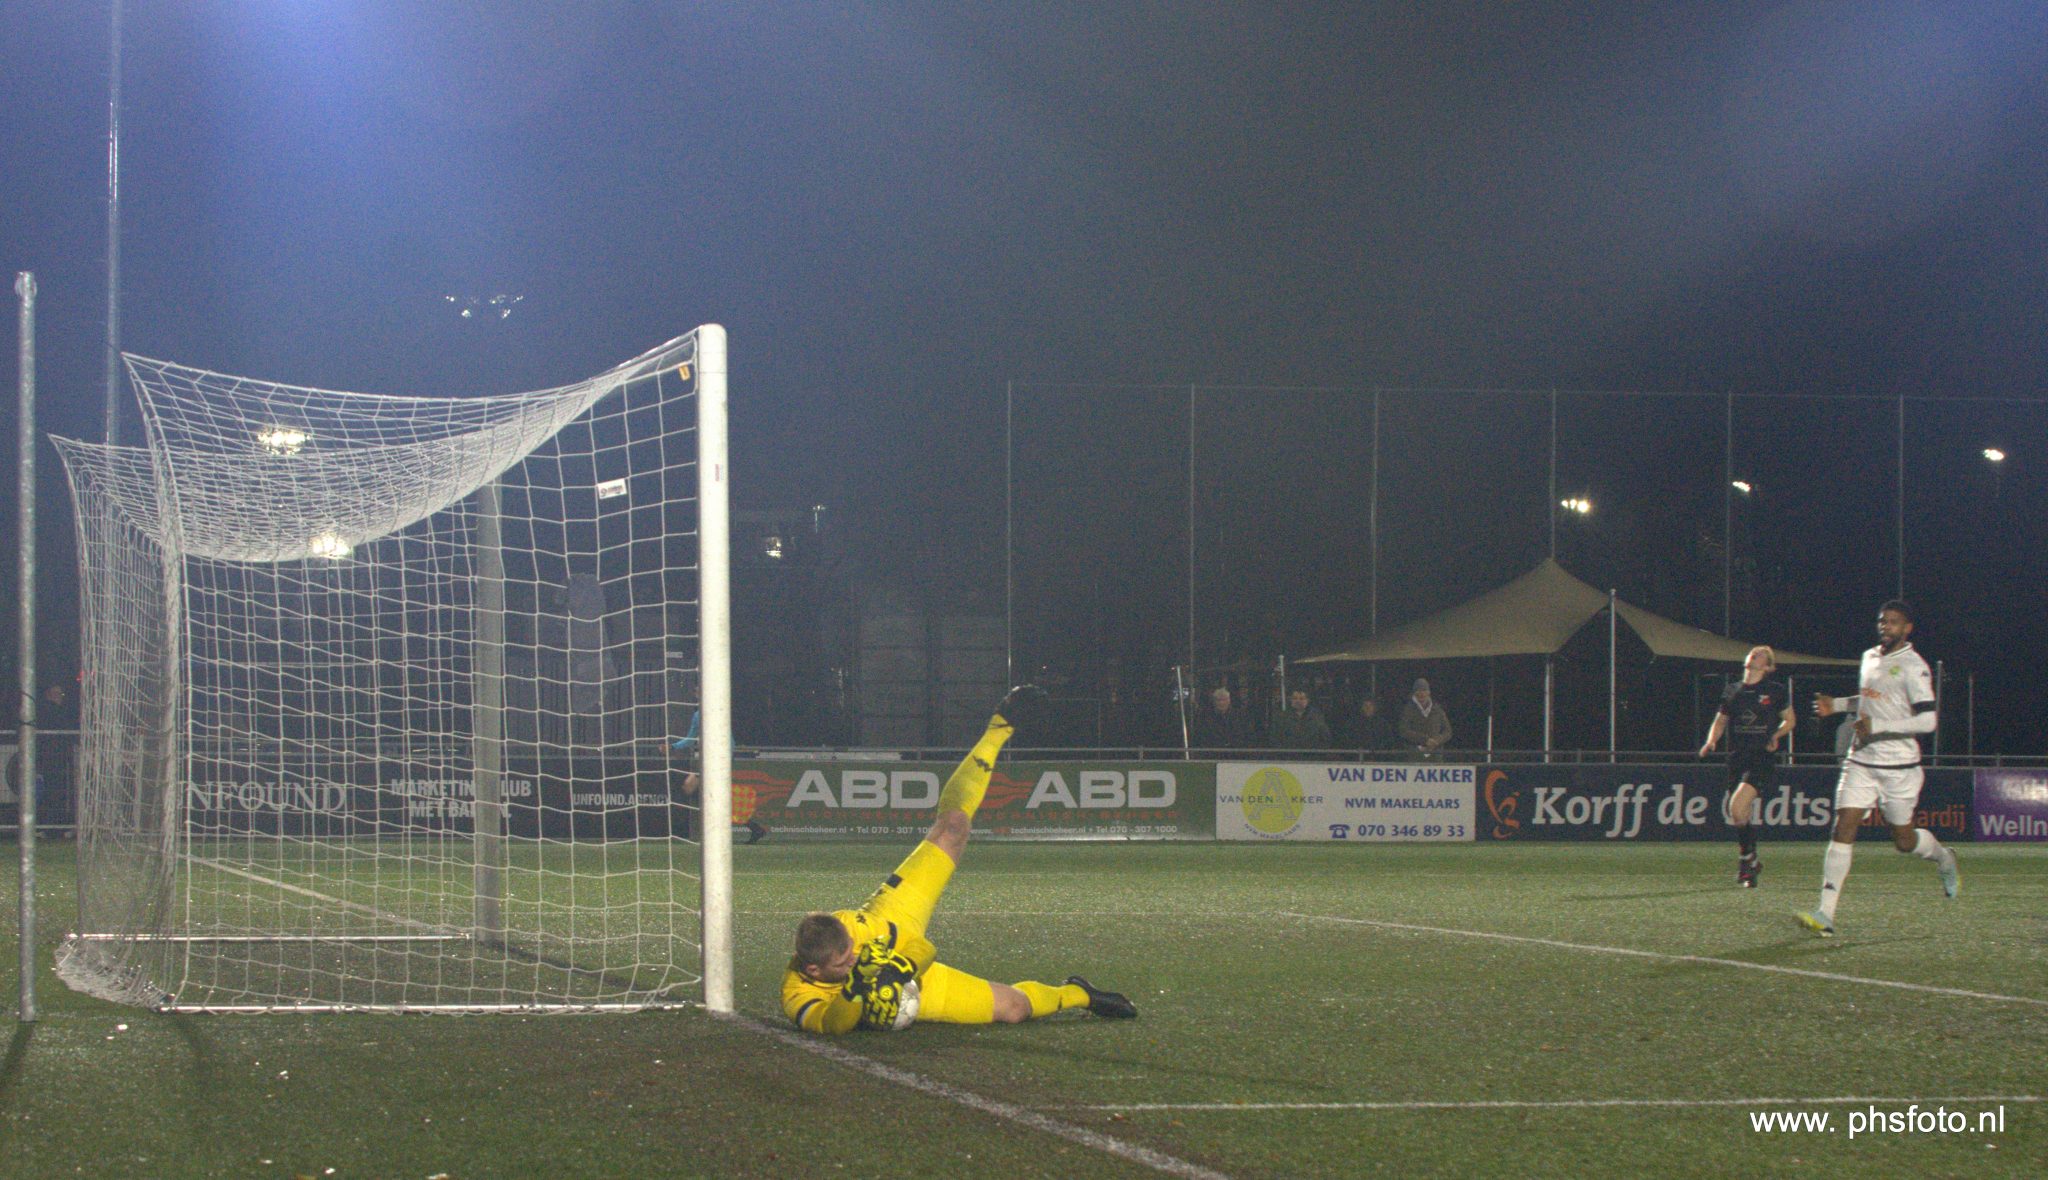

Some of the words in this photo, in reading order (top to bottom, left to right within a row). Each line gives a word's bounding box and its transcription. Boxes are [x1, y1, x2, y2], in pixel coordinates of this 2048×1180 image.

[1327, 768, 1366, 783] VAN
[1371, 769, 1408, 783] DEN
[1414, 769, 1473, 783] AKKER
[391, 779, 475, 796] MARKETIN
[500, 780, 532, 797] LUB
[786, 770, 940, 808] ABD
[1026, 770, 1177, 808] ABD
[1220, 795, 1244, 803] VAN
[1248, 795, 1273, 803] DEN
[1345, 798, 1377, 809] NVM
[1381, 798, 1460, 810] MAKELAARS
[1532, 784, 1653, 838] Korff
[1657, 785, 1708, 825] de
[857, 826, 869, 834] Tel
[1096, 825, 1109, 833] Tel
[1358, 824, 1385, 837] 070
[1391, 824, 1418, 837] 346
[1424, 824, 1441, 837] 89
[1447, 824, 1464, 837] 33
[1980, 814, 2048, 836] Welln
